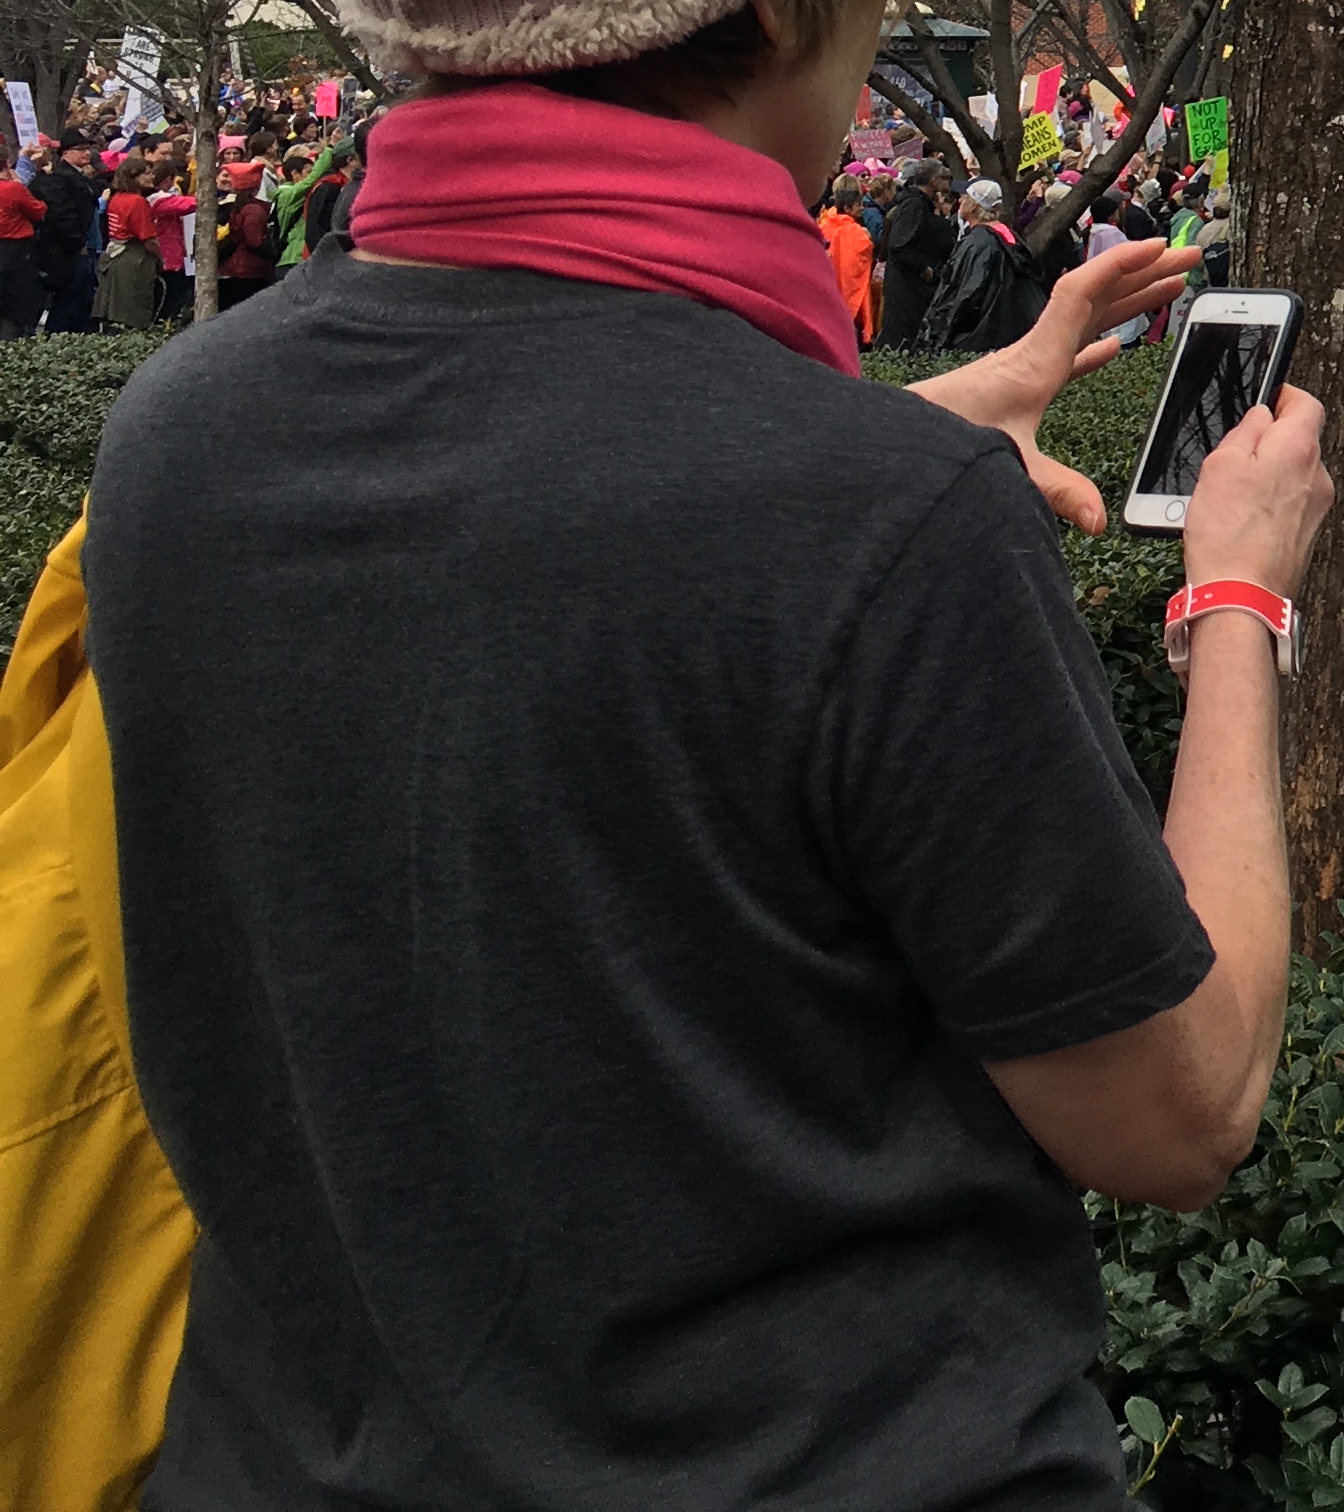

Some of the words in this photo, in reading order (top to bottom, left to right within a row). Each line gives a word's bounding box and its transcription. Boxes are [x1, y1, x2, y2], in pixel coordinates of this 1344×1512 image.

[1192, 99, 1221, 117] NOT
[1200, 117, 1217, 130] UP
[1193, 130, 1221, 146] FOR
[1022, 140, 1057, 162] OMEN
